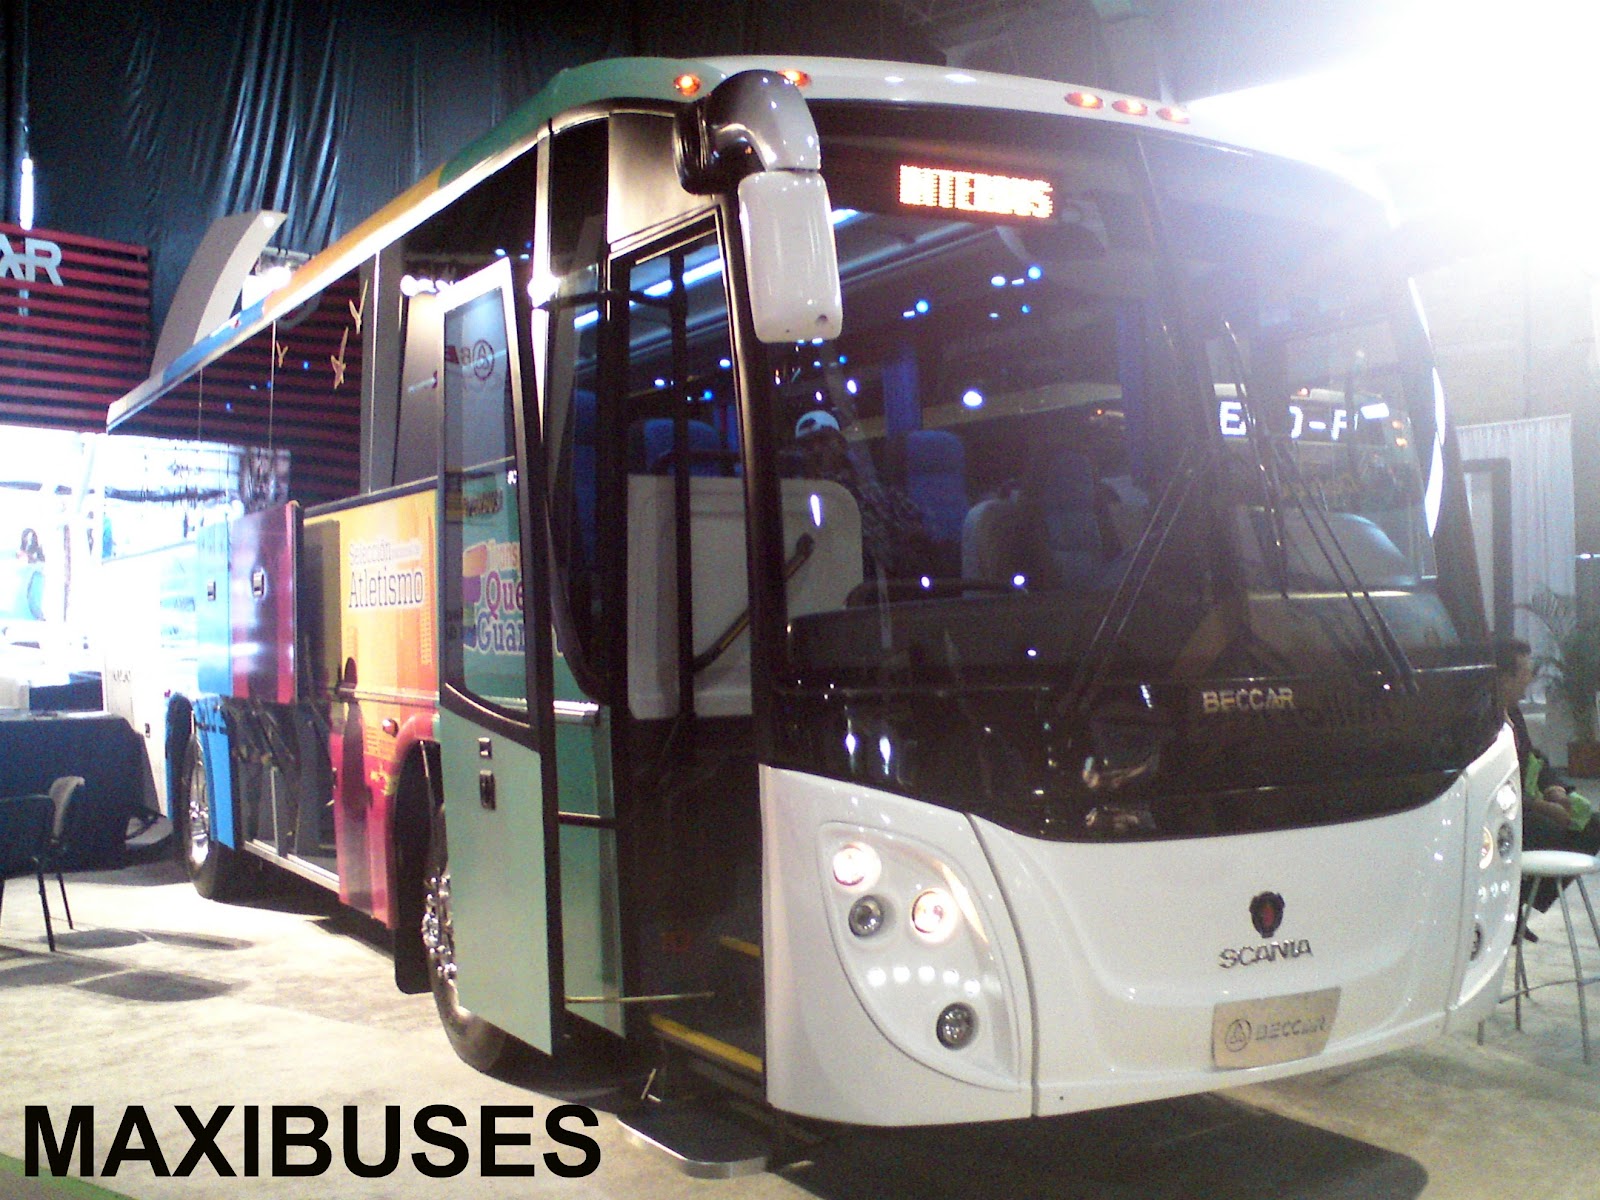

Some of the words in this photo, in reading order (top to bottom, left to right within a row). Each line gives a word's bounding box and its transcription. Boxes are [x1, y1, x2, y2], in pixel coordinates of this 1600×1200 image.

[348, 565, 423, 608] Atletismo
[1202, 687, 1297, 713] BECCAR
[1219, 939, 1314, 969] SCANIA
